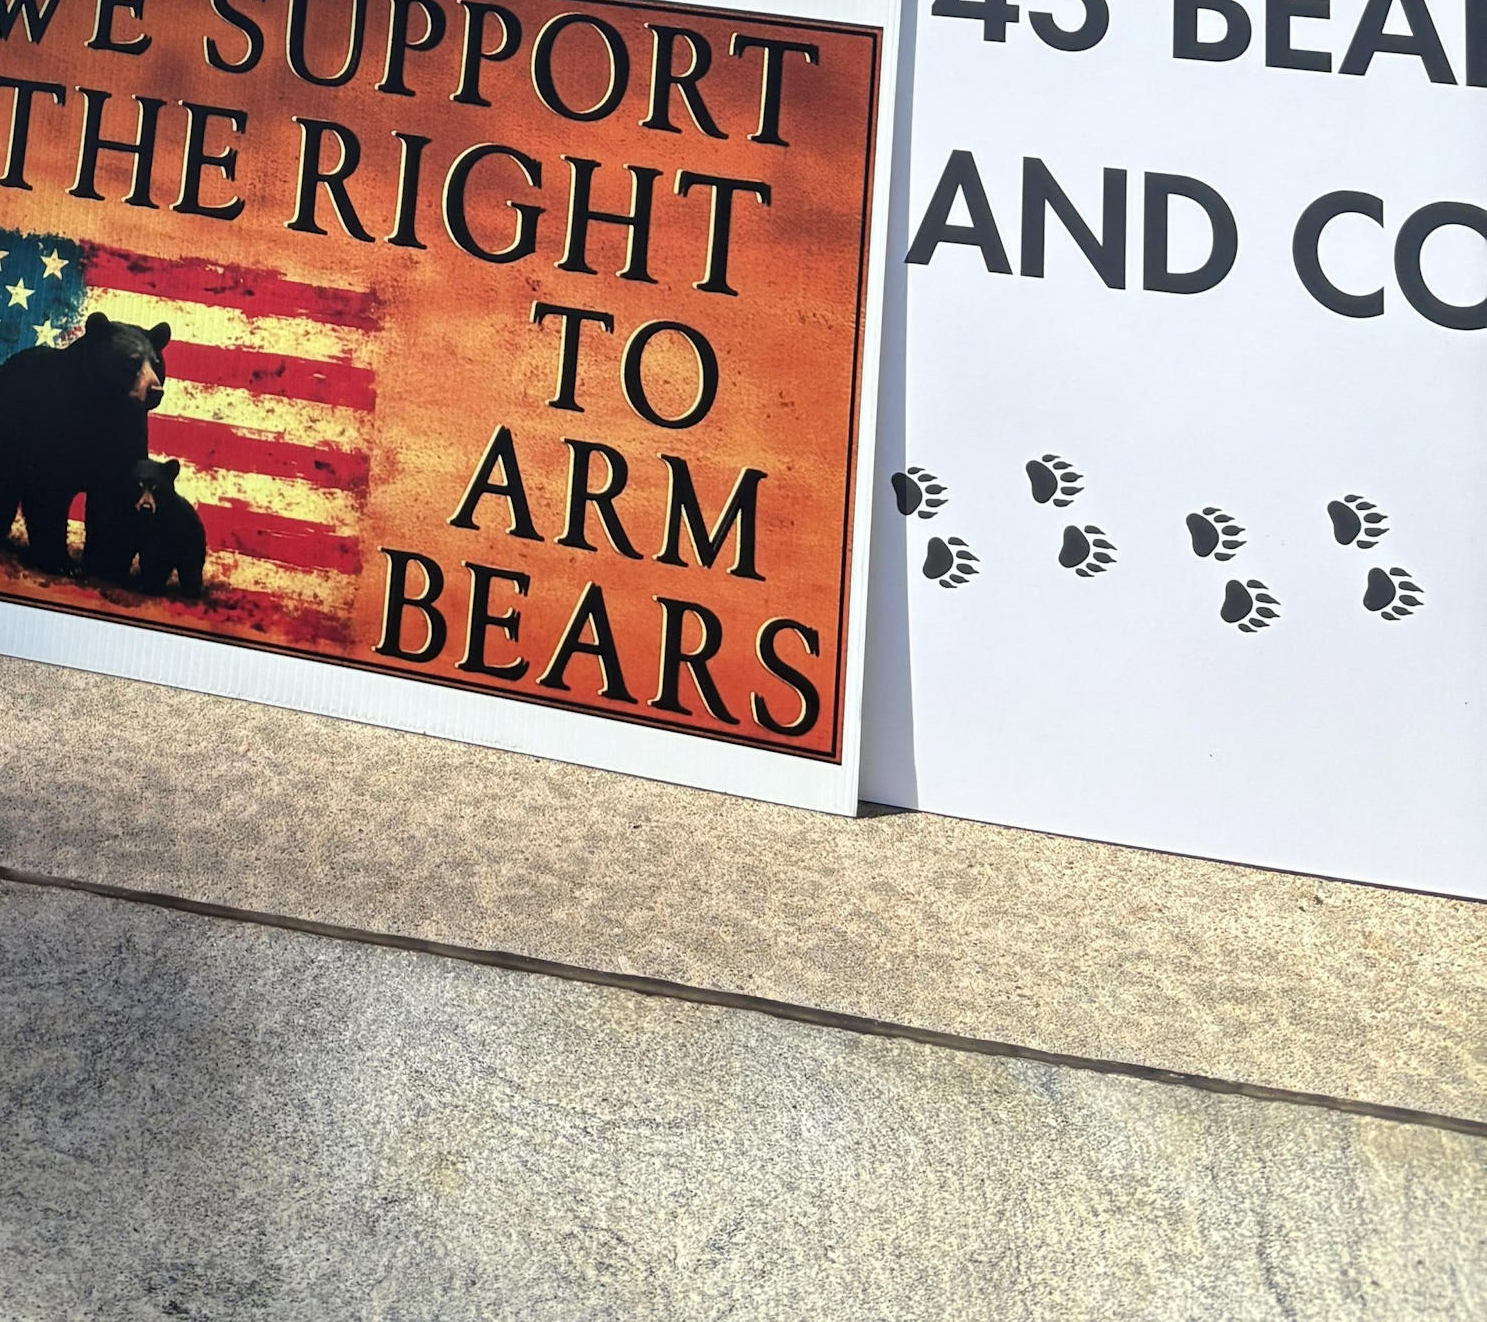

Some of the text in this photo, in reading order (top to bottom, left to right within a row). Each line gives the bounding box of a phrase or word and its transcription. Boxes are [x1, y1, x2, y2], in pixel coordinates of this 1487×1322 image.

[287, 114, 774, 296] RIGHT
[905, 148, 1238, 295] AND
[530, 297, 719, 430] TO
[447, 424, 770, 583] ARM
[373, 544, 824, 738] BEARS
